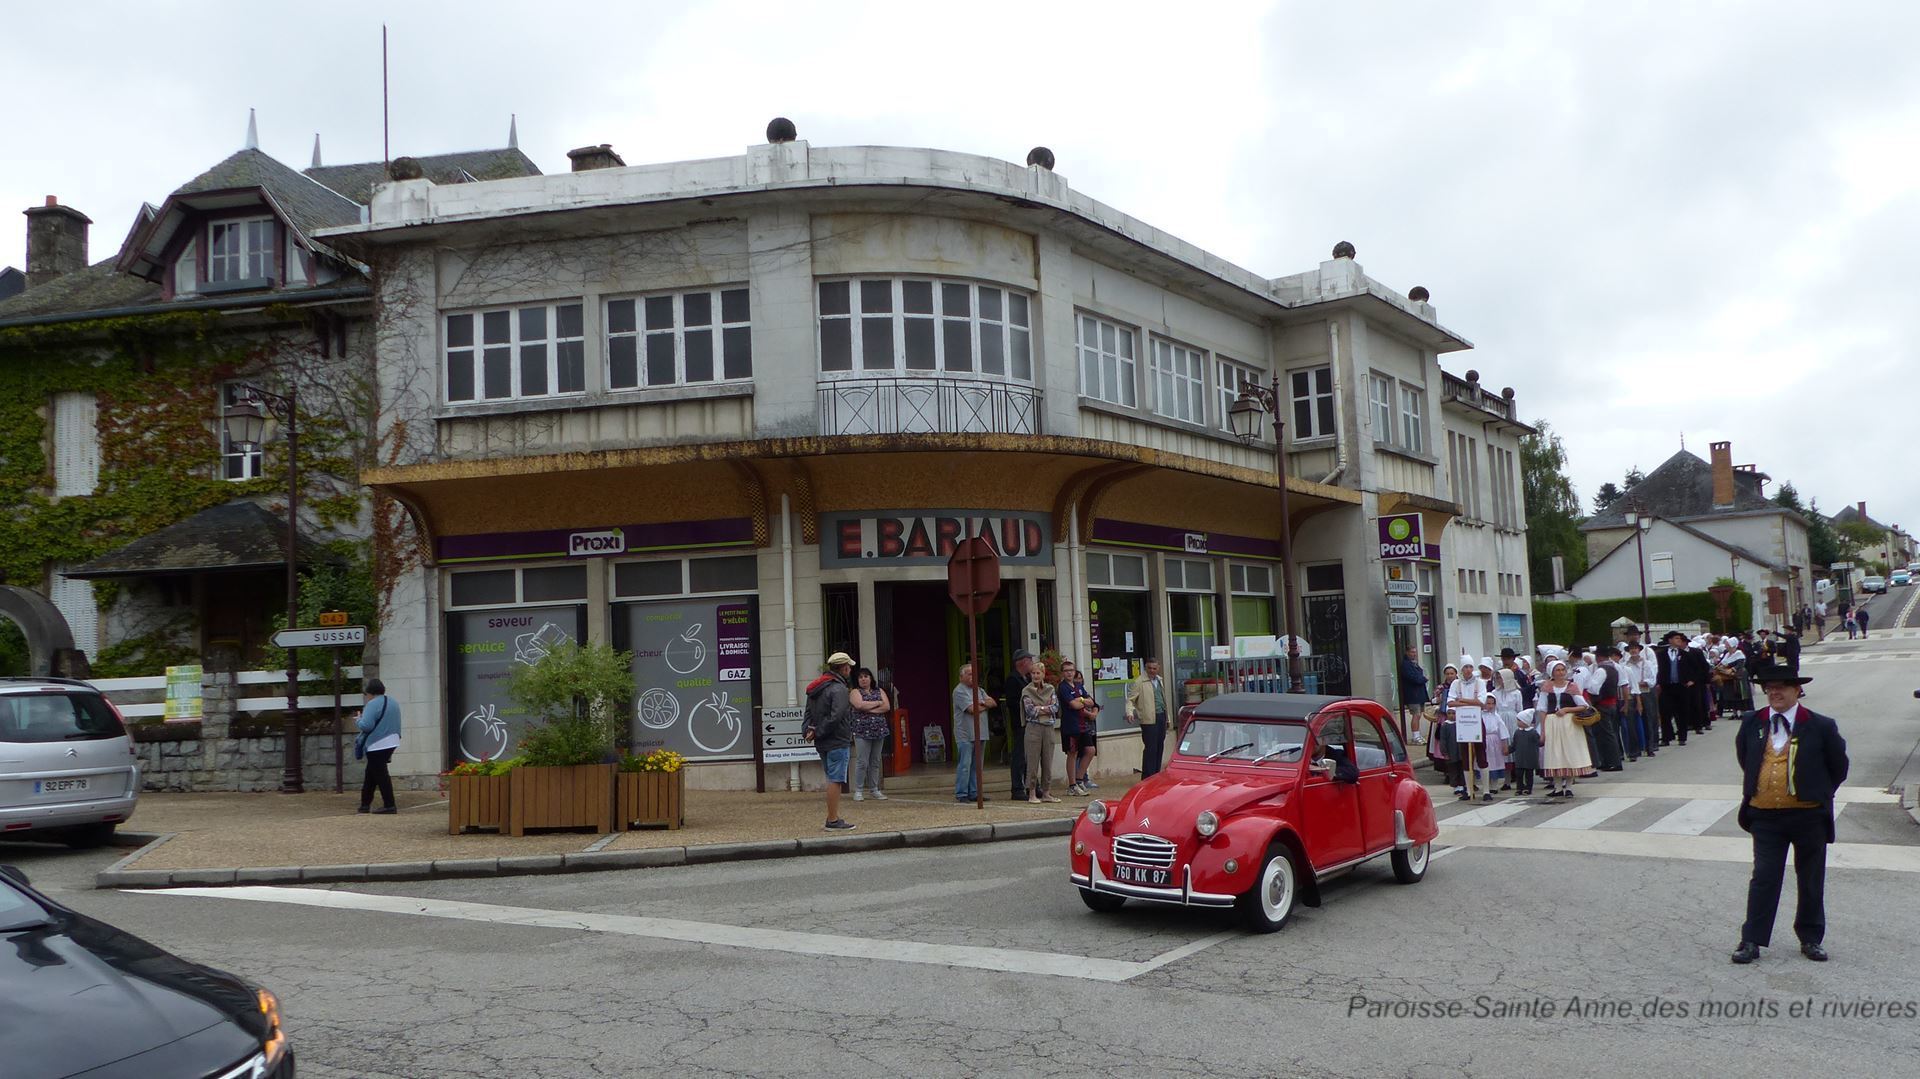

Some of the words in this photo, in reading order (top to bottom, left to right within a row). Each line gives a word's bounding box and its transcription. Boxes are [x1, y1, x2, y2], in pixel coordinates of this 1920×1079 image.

[572, 528, 620, 551] Proxi
[1380, 536, 1419, 556] Proxi
[488, 616, 533, 629] saveur
[314, 631, 361, 642] SUSSAC
[457, 641, 506, 654] service
[727, 669, 746, 679] GAZ
[769, 709, 803, 719] Cabinet
[1115, 865, 1130, 880] 760
[1134, 867, 1147, 882] KK
[1153, 869, 1166, 884] 87
